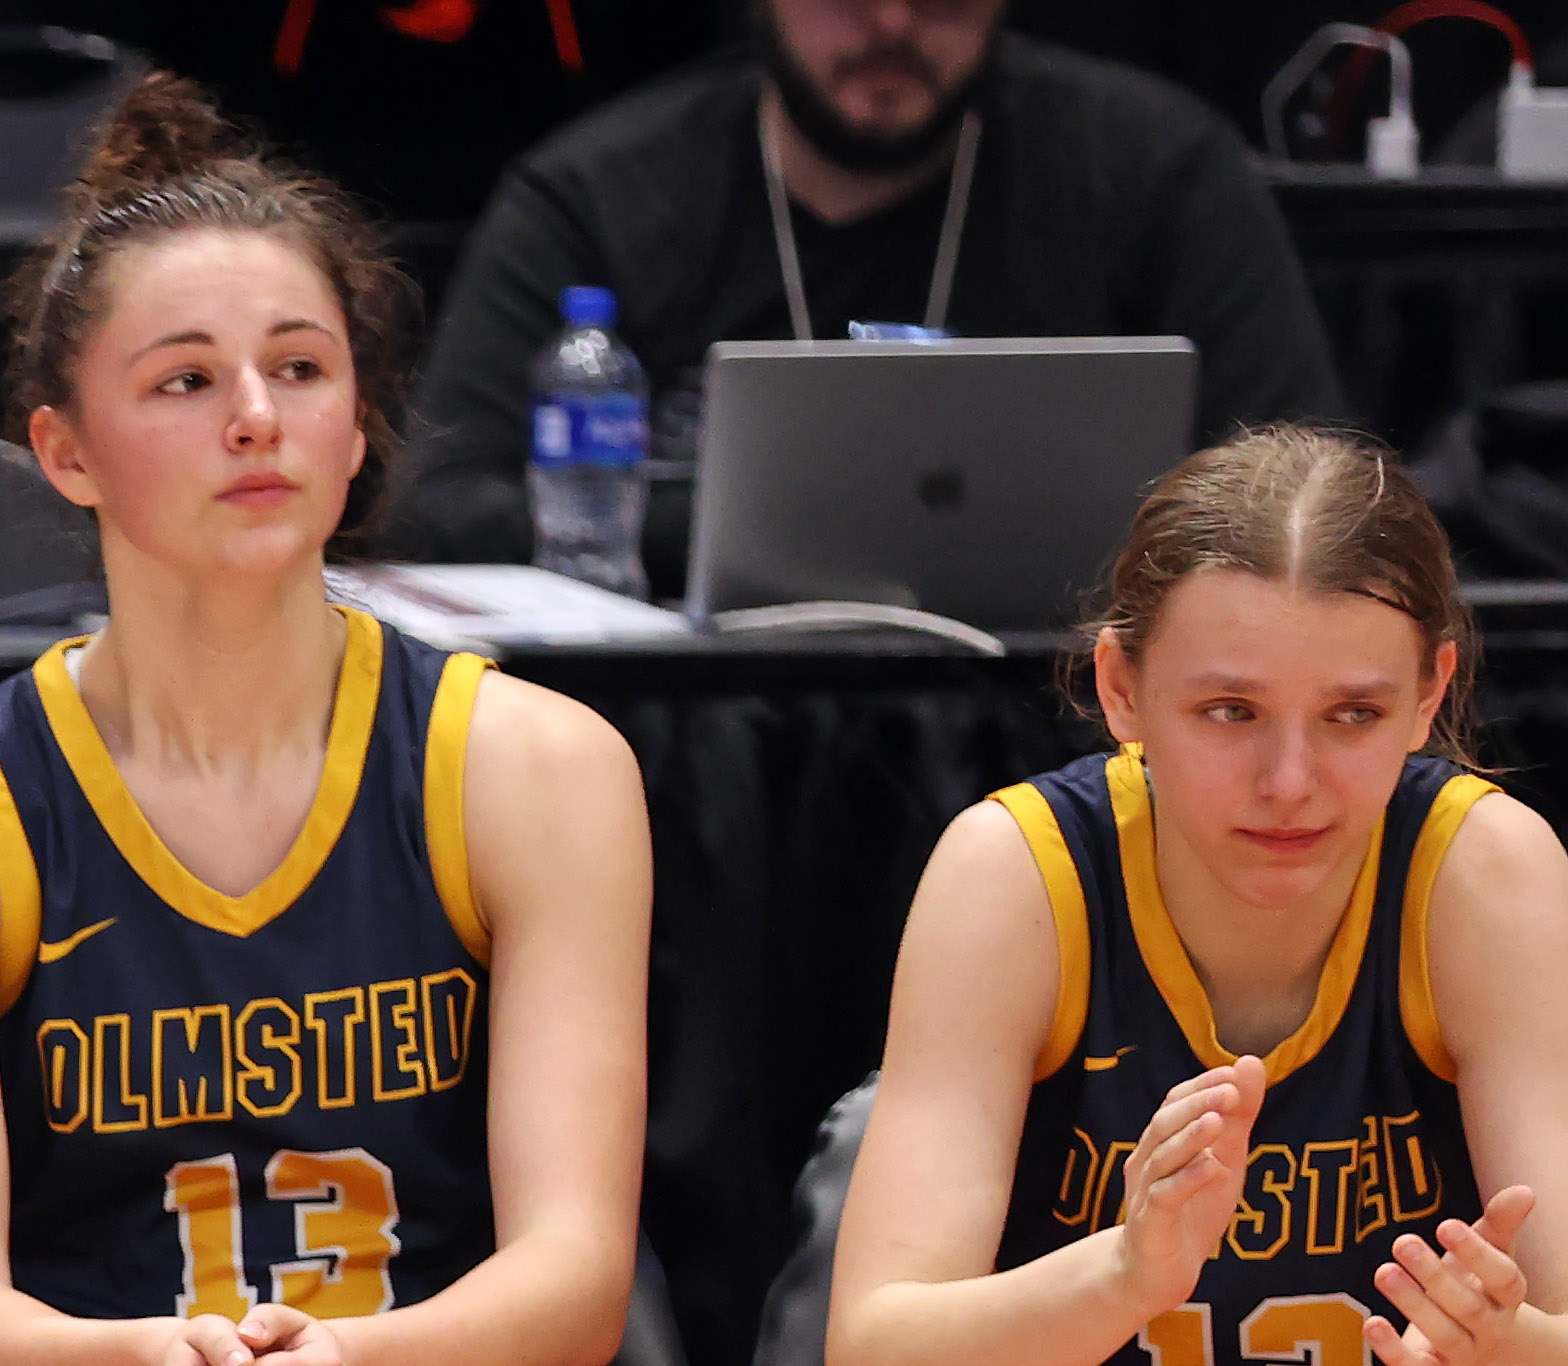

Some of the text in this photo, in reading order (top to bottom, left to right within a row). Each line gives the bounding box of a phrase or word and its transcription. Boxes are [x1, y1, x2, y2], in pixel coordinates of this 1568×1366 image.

[37, 968, 476, 1133] OLMSTED
[164, 1147, 401, 1320] 13
[1052, 1110, 1444, 1260] OSTED
